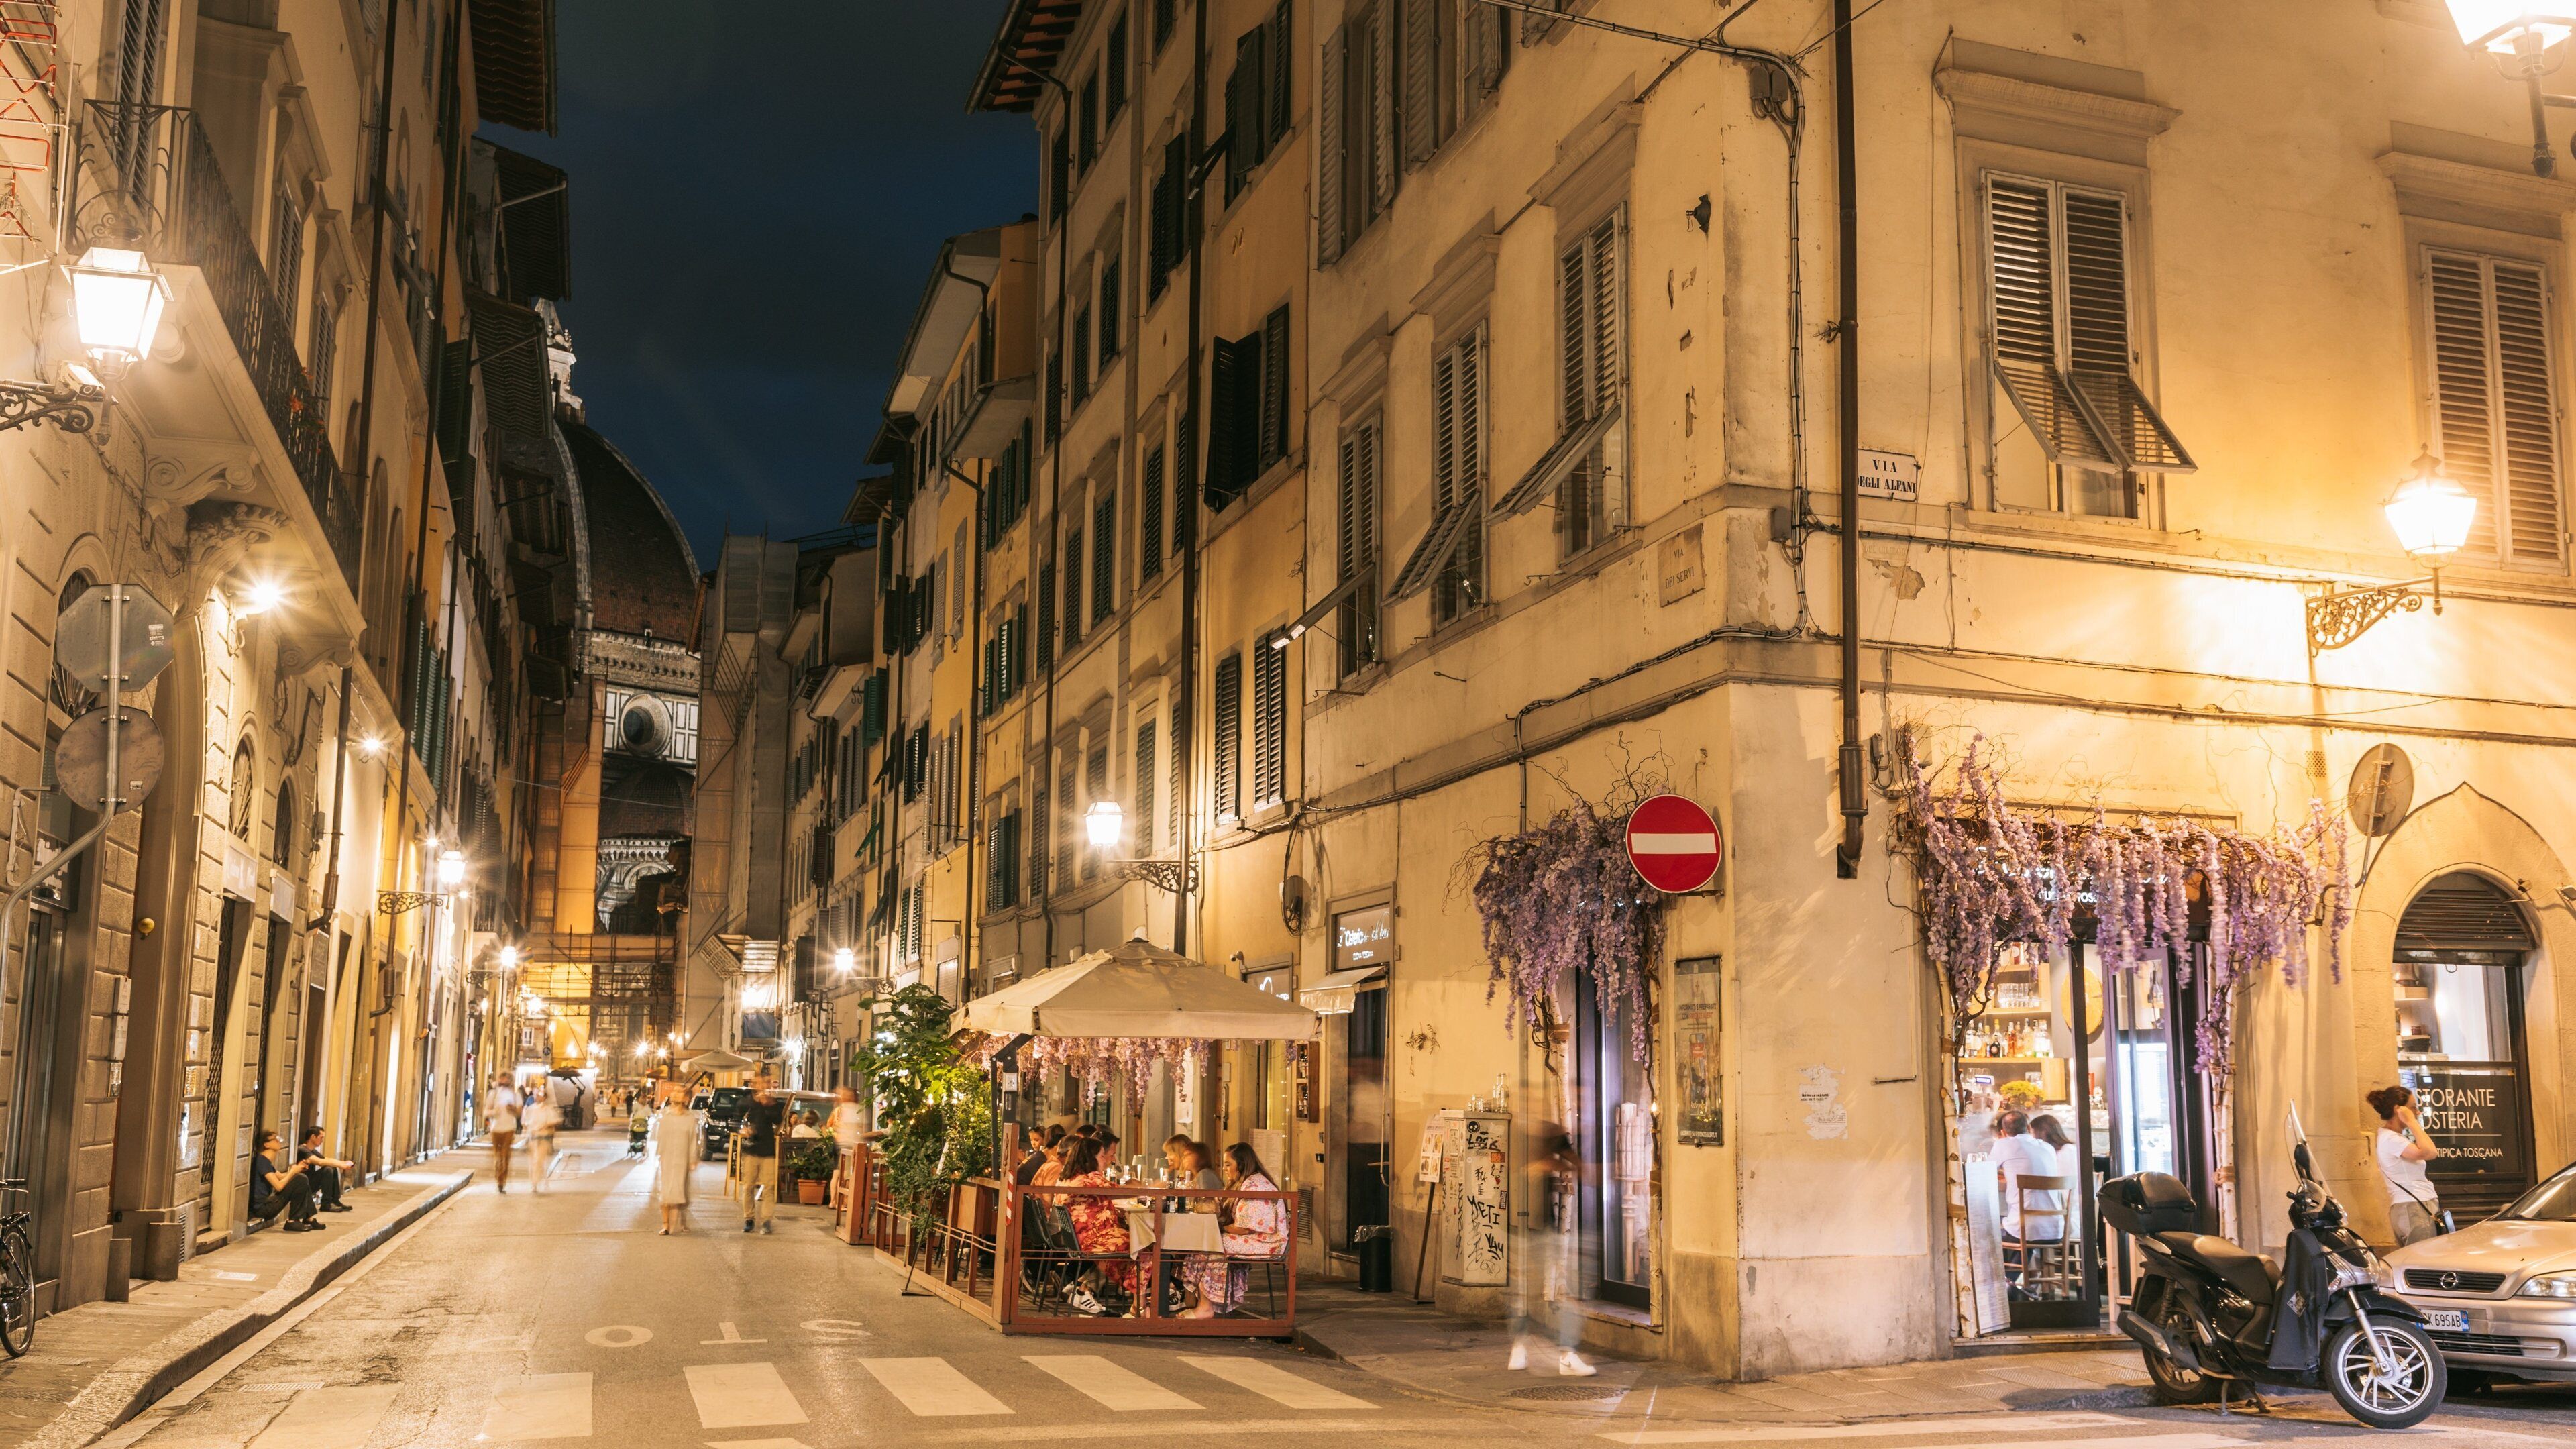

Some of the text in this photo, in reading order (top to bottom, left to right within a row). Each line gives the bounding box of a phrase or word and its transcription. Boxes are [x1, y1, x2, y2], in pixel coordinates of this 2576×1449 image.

[1872, 459, 1898, 473] VIA
[1884, 478, 1917, 494] ALFANI
[1674, 549, 1684, 558] VIA
[1666, 566, 1694, 588] DEI SERVI
[2415, 1088, 2496, 1108] STORANTE
[2437, 1147, 2504, 1159] TIPICA TOSCANA
[2434, 1313, 2461, 1327] 695AB
